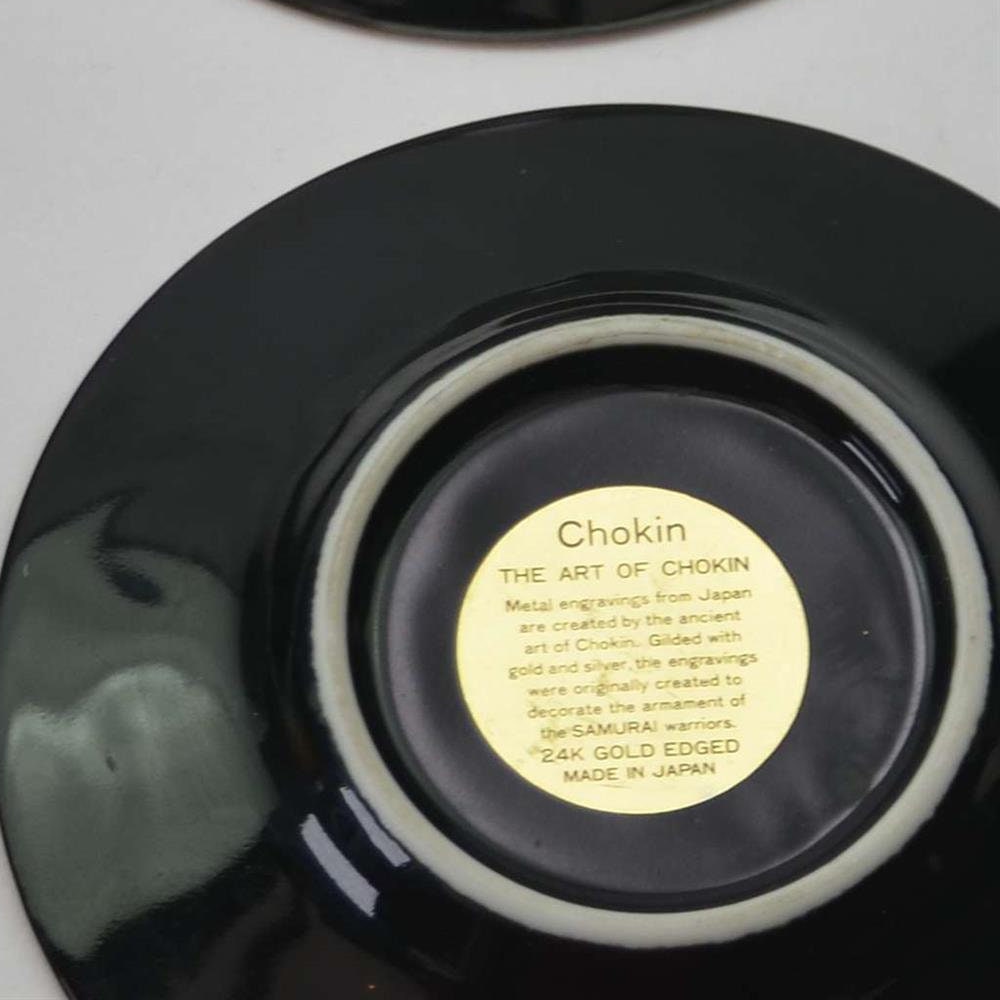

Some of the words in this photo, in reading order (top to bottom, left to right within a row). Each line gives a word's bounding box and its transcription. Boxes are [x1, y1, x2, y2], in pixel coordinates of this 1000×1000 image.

[557, 515, 686, 548] Chokin
[499, 566, 547, 584] THE
[559, 564, 604, 581] ART
[617, 561, 651, 579] OF
[661, 556, 750, 577] CHOKIN
[505, 597, 553, 613] Metal
[558, 593, 650, 612] engravings
[655, 590, 692, 604] from
[698, 587, 752, 602] Japan
[519, 622, 546, 634] are
[551, 617, 617, 632] created
[621, 615, 641, 631] by
[645, 612, 673, 627] the
[678, 609, 742, 625] ancient
[524, 641, 549, 655] art
[553, 639, 571, 653] of
[648, 632, 703, 648] Gilded
[707, 629, 742, 644] with
[507, 664, 544, 681] gold
[548, 662, 579, 676] and
[635, 656, 662, 670] the
[668, 651, 759, 671] engravings
[527, 685, 569, 698] were
[572, 678, 649, 698] originally
[655, 674, 720, 690] created
[725, 673, 744, 686] to
[527, 703, 603, 719] decorate
[609, 700, 636, 715] the
[642, 695, 724, 712] armament
[730, 692, 747, 708] of
[540, 725, 567, 741] the
[571, 719, 659, 738] SAMURAI
[664, 716, 738, 732] warriors.
[540, 746, 585, 764] 24K
[593, 743, 656, 761] GOLD
[664, 738, 741, 757] EDGED
[563, 767, 619, 783] MADE
[626, 765, 645, 779] IN
[651, 761, 717, 778] JAPAN
